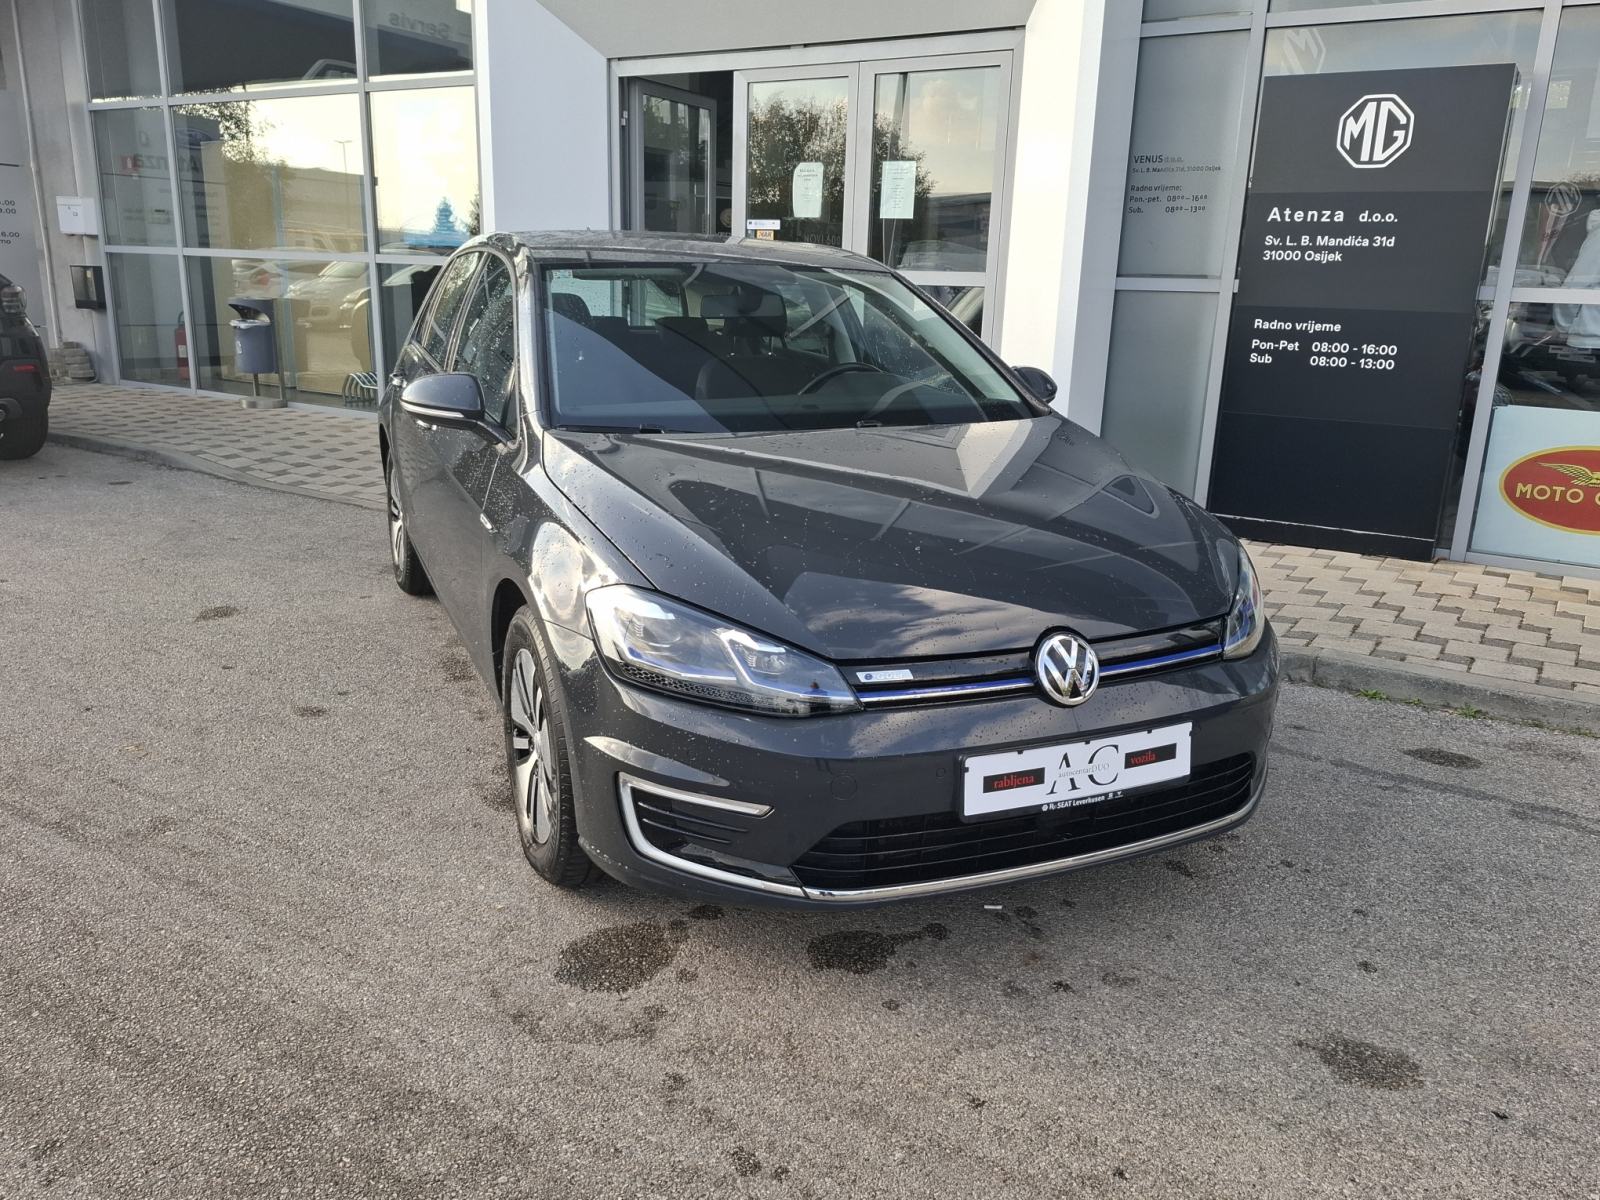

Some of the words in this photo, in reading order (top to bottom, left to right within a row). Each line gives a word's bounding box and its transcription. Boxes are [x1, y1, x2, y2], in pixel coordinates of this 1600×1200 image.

[1343, 100, 1408, 161] MG
[1134, 154, 1164, 164] VENUS
[1154, 184, 1183, 192] vrijeme:
[1267, 206, 1345, 222] Atenza
[1359, 210, 1398, 222] d.o.o.
[1264, 235, 1283, 246] Sv.
[1286, 235, 1298, 246] L.
[1301, 235, 1313, 246] B.
[1316, 235, 1369, 247] Mandića
[1372, 236, 1396, 247] 31d
[1262, 250, 1302, 261] 31000
[1304, 250, 1343, 264] Osijek
[1254, 318, 1292, 330] Radno
[1295, 320, 1342, 334] vrijeme
[1251, 339, 1300, 351] Pon-Pet
[1312, 342, 1350, 354] 08:00
[1361, 344, 1398, 356] 16:00
[1249, 353, 1272, 364] Sub
[1310, 355, 1348, 367] 08:00
[1359, 358, 1395, 370] 13:00
[1515, 482, 1584, 504] MOTO
[1130, 752, 1156, 765] vozila
[1046, 744, 1120, 795] AC
[993, 773, 1035, 789] rabljena
[1057, 801, 1072, 809] SEAT
[1073, 795, 1105, 806] Leverkusen
